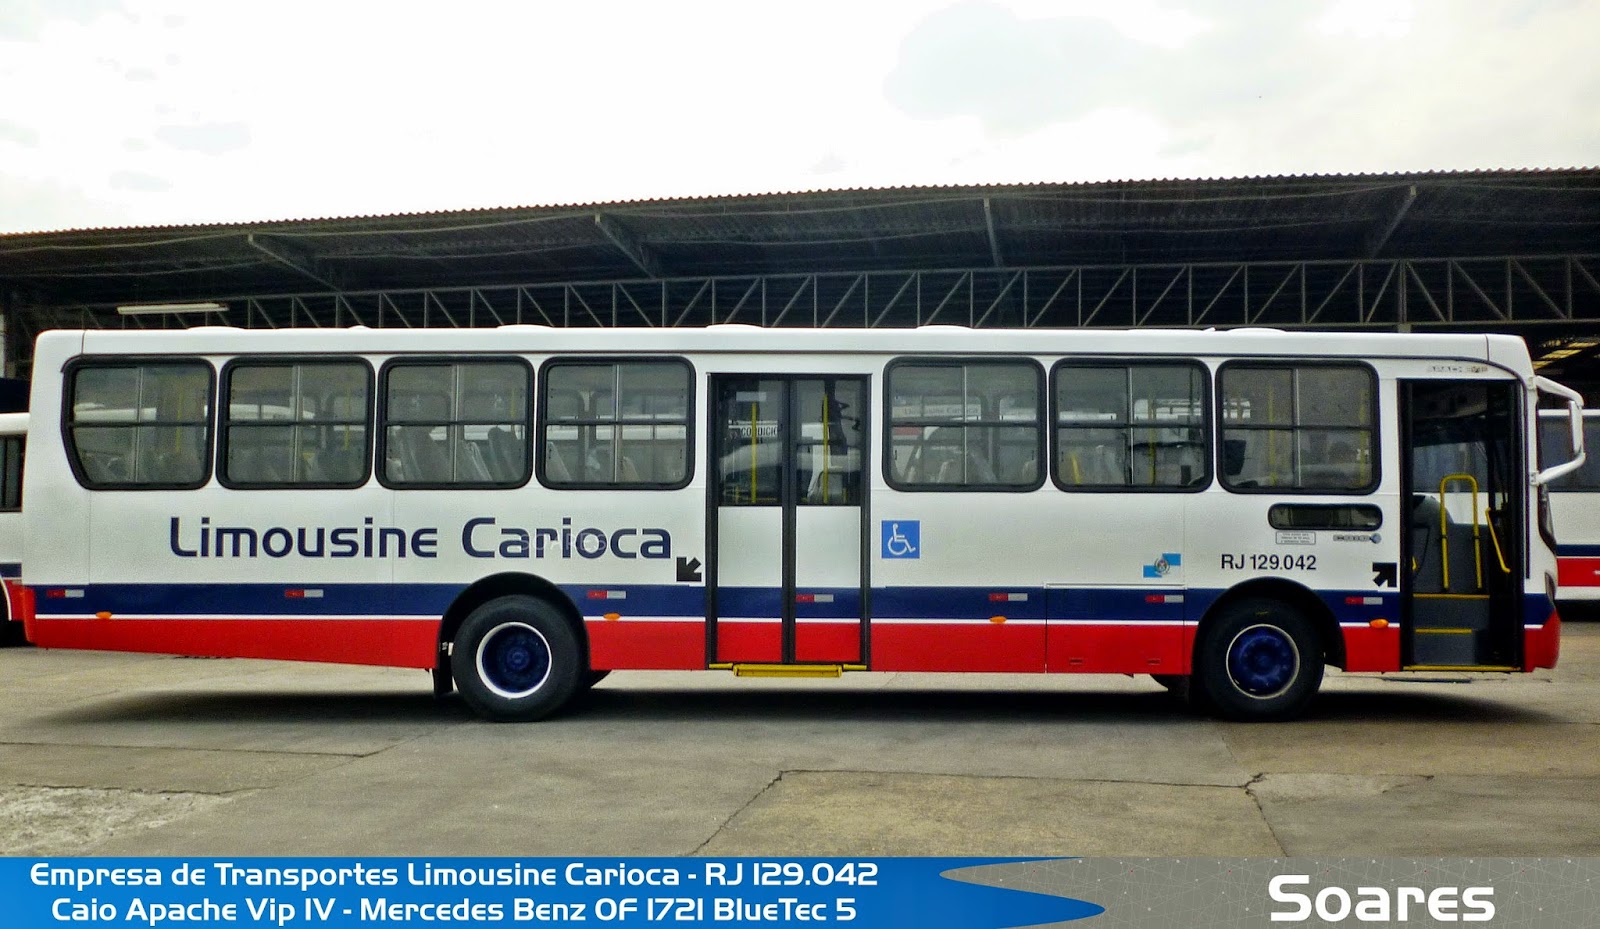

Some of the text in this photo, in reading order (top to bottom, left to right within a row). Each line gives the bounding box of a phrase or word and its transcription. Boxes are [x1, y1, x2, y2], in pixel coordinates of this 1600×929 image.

[170, 517, 671, 559] Limousine Carioca
[1221, 553, 1317, 571] RJ 129.042
